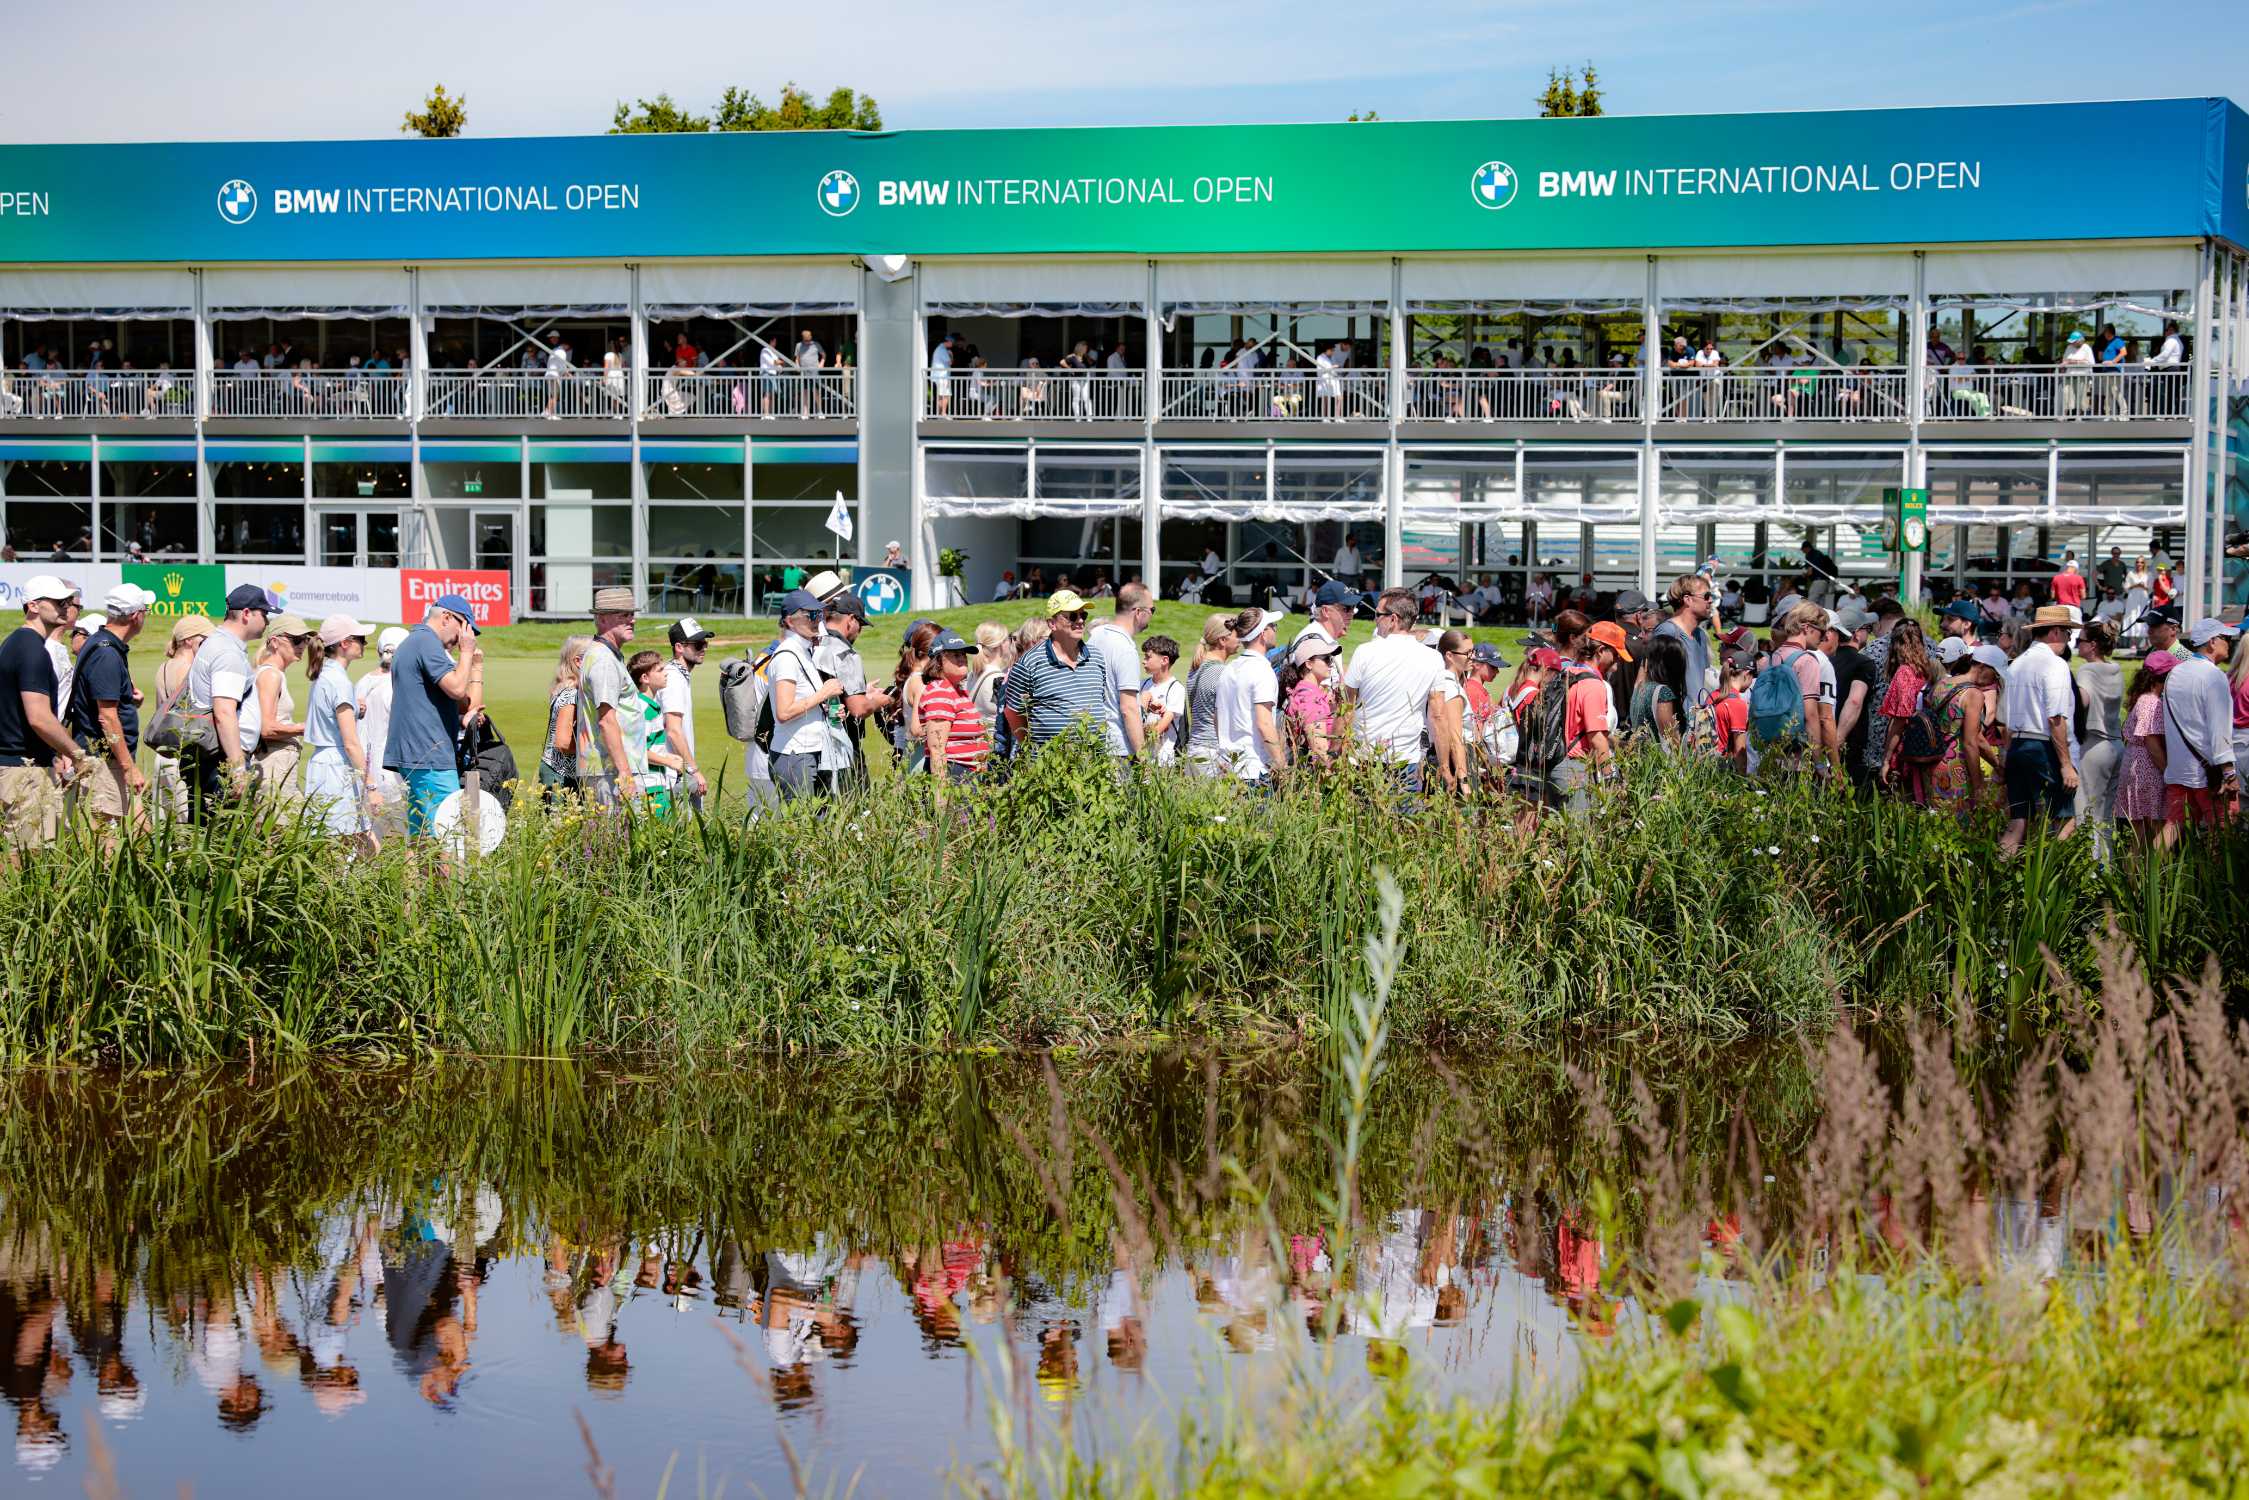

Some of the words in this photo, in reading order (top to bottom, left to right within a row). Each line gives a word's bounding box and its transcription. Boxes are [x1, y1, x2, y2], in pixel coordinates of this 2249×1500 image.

[878, 180, 950, 206] BMW
[957, 178, 1185, 205] INTERNATIONAL
[1193, 176, 1273, 203] OPEN
[1539, 171, 1617, 198] BMW
[1625, 164, 1879, 195] INTERNATIONAL
[1890, 161, 1980, 190] OPEN
[0, 192, 49, 215] PEN
[274, 189, 340, 214] BMW
[347, 186, 558, 213] INTERNATIONAL
[565, 184, 639, 210] OPEN
[408, 578, 503, 602] Emirates
[864, 575, 898, 589] BMW
[289, 590, 360, 602] commercetools
